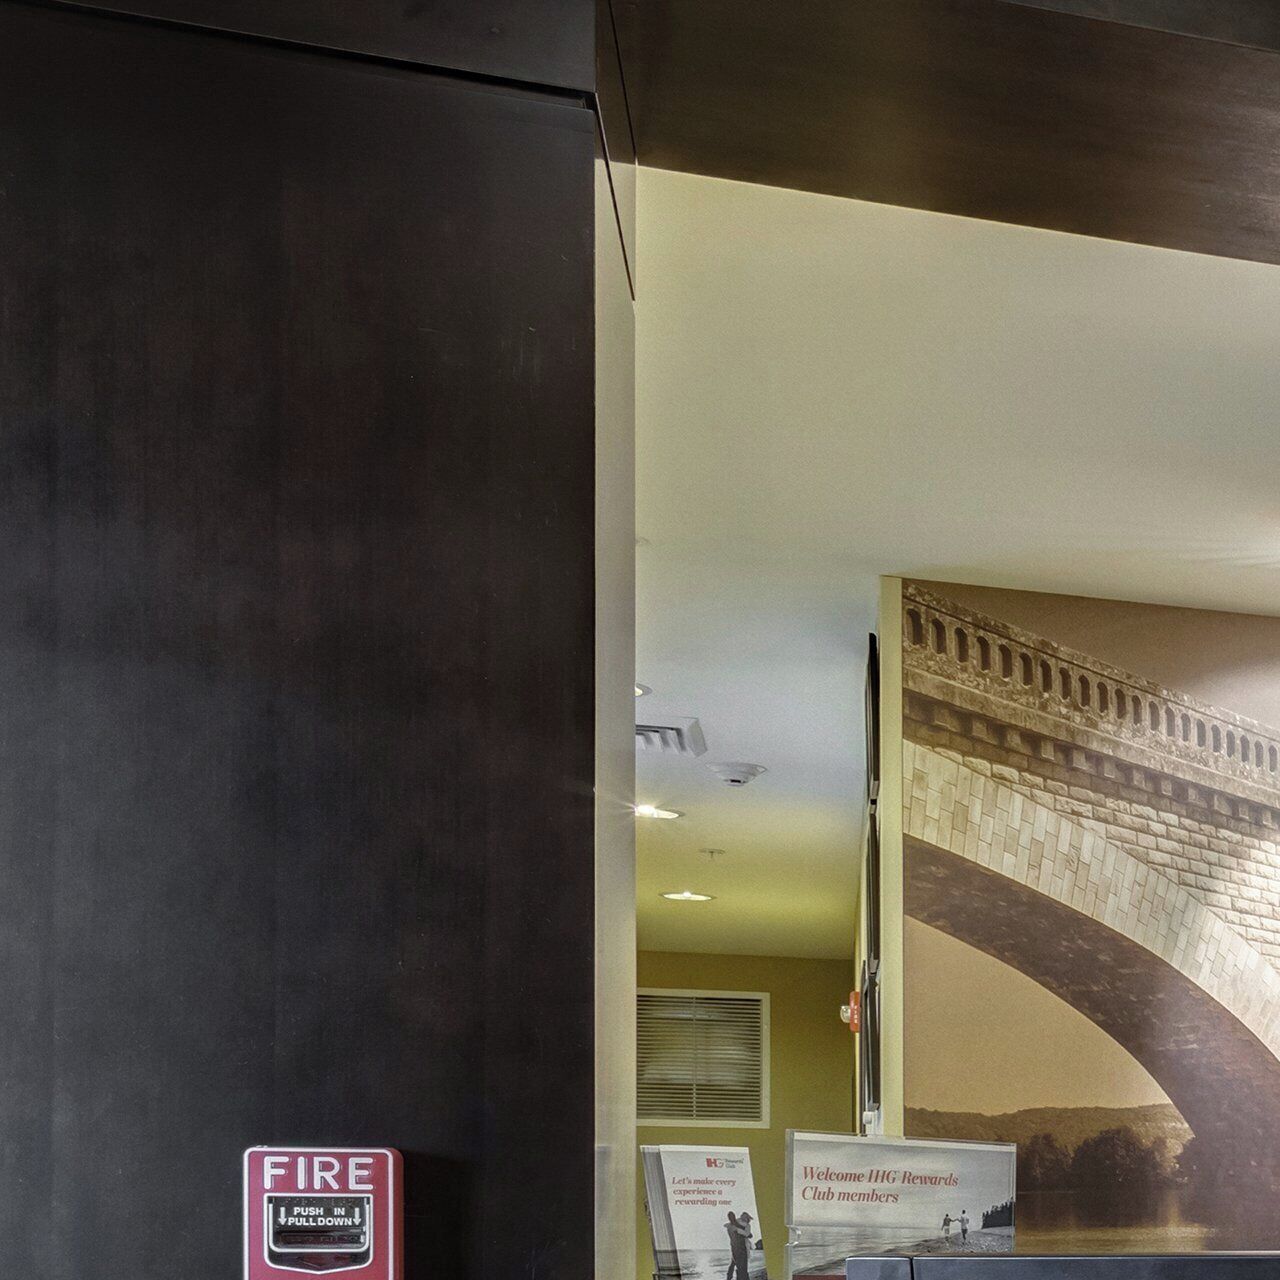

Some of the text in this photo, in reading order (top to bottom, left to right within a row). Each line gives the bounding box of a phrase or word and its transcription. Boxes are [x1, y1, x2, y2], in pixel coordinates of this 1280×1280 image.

[264, 1156, 374, 1190] FIRE
[802, 1166, 959, 1187] Welcome IHG Rewards
[672, 1176, 692, 1185] Let's
[693, 1177, 714, 1185] make
[673, 1187, 717, 1196] experience
[801, 1185, 899, 1204] Club members
[675, 1198, 717, 1206] rewarding
[294, 1207, 345, 1216] PUSH IN
[287, 1217, 352, 1226] PULL DOWN
